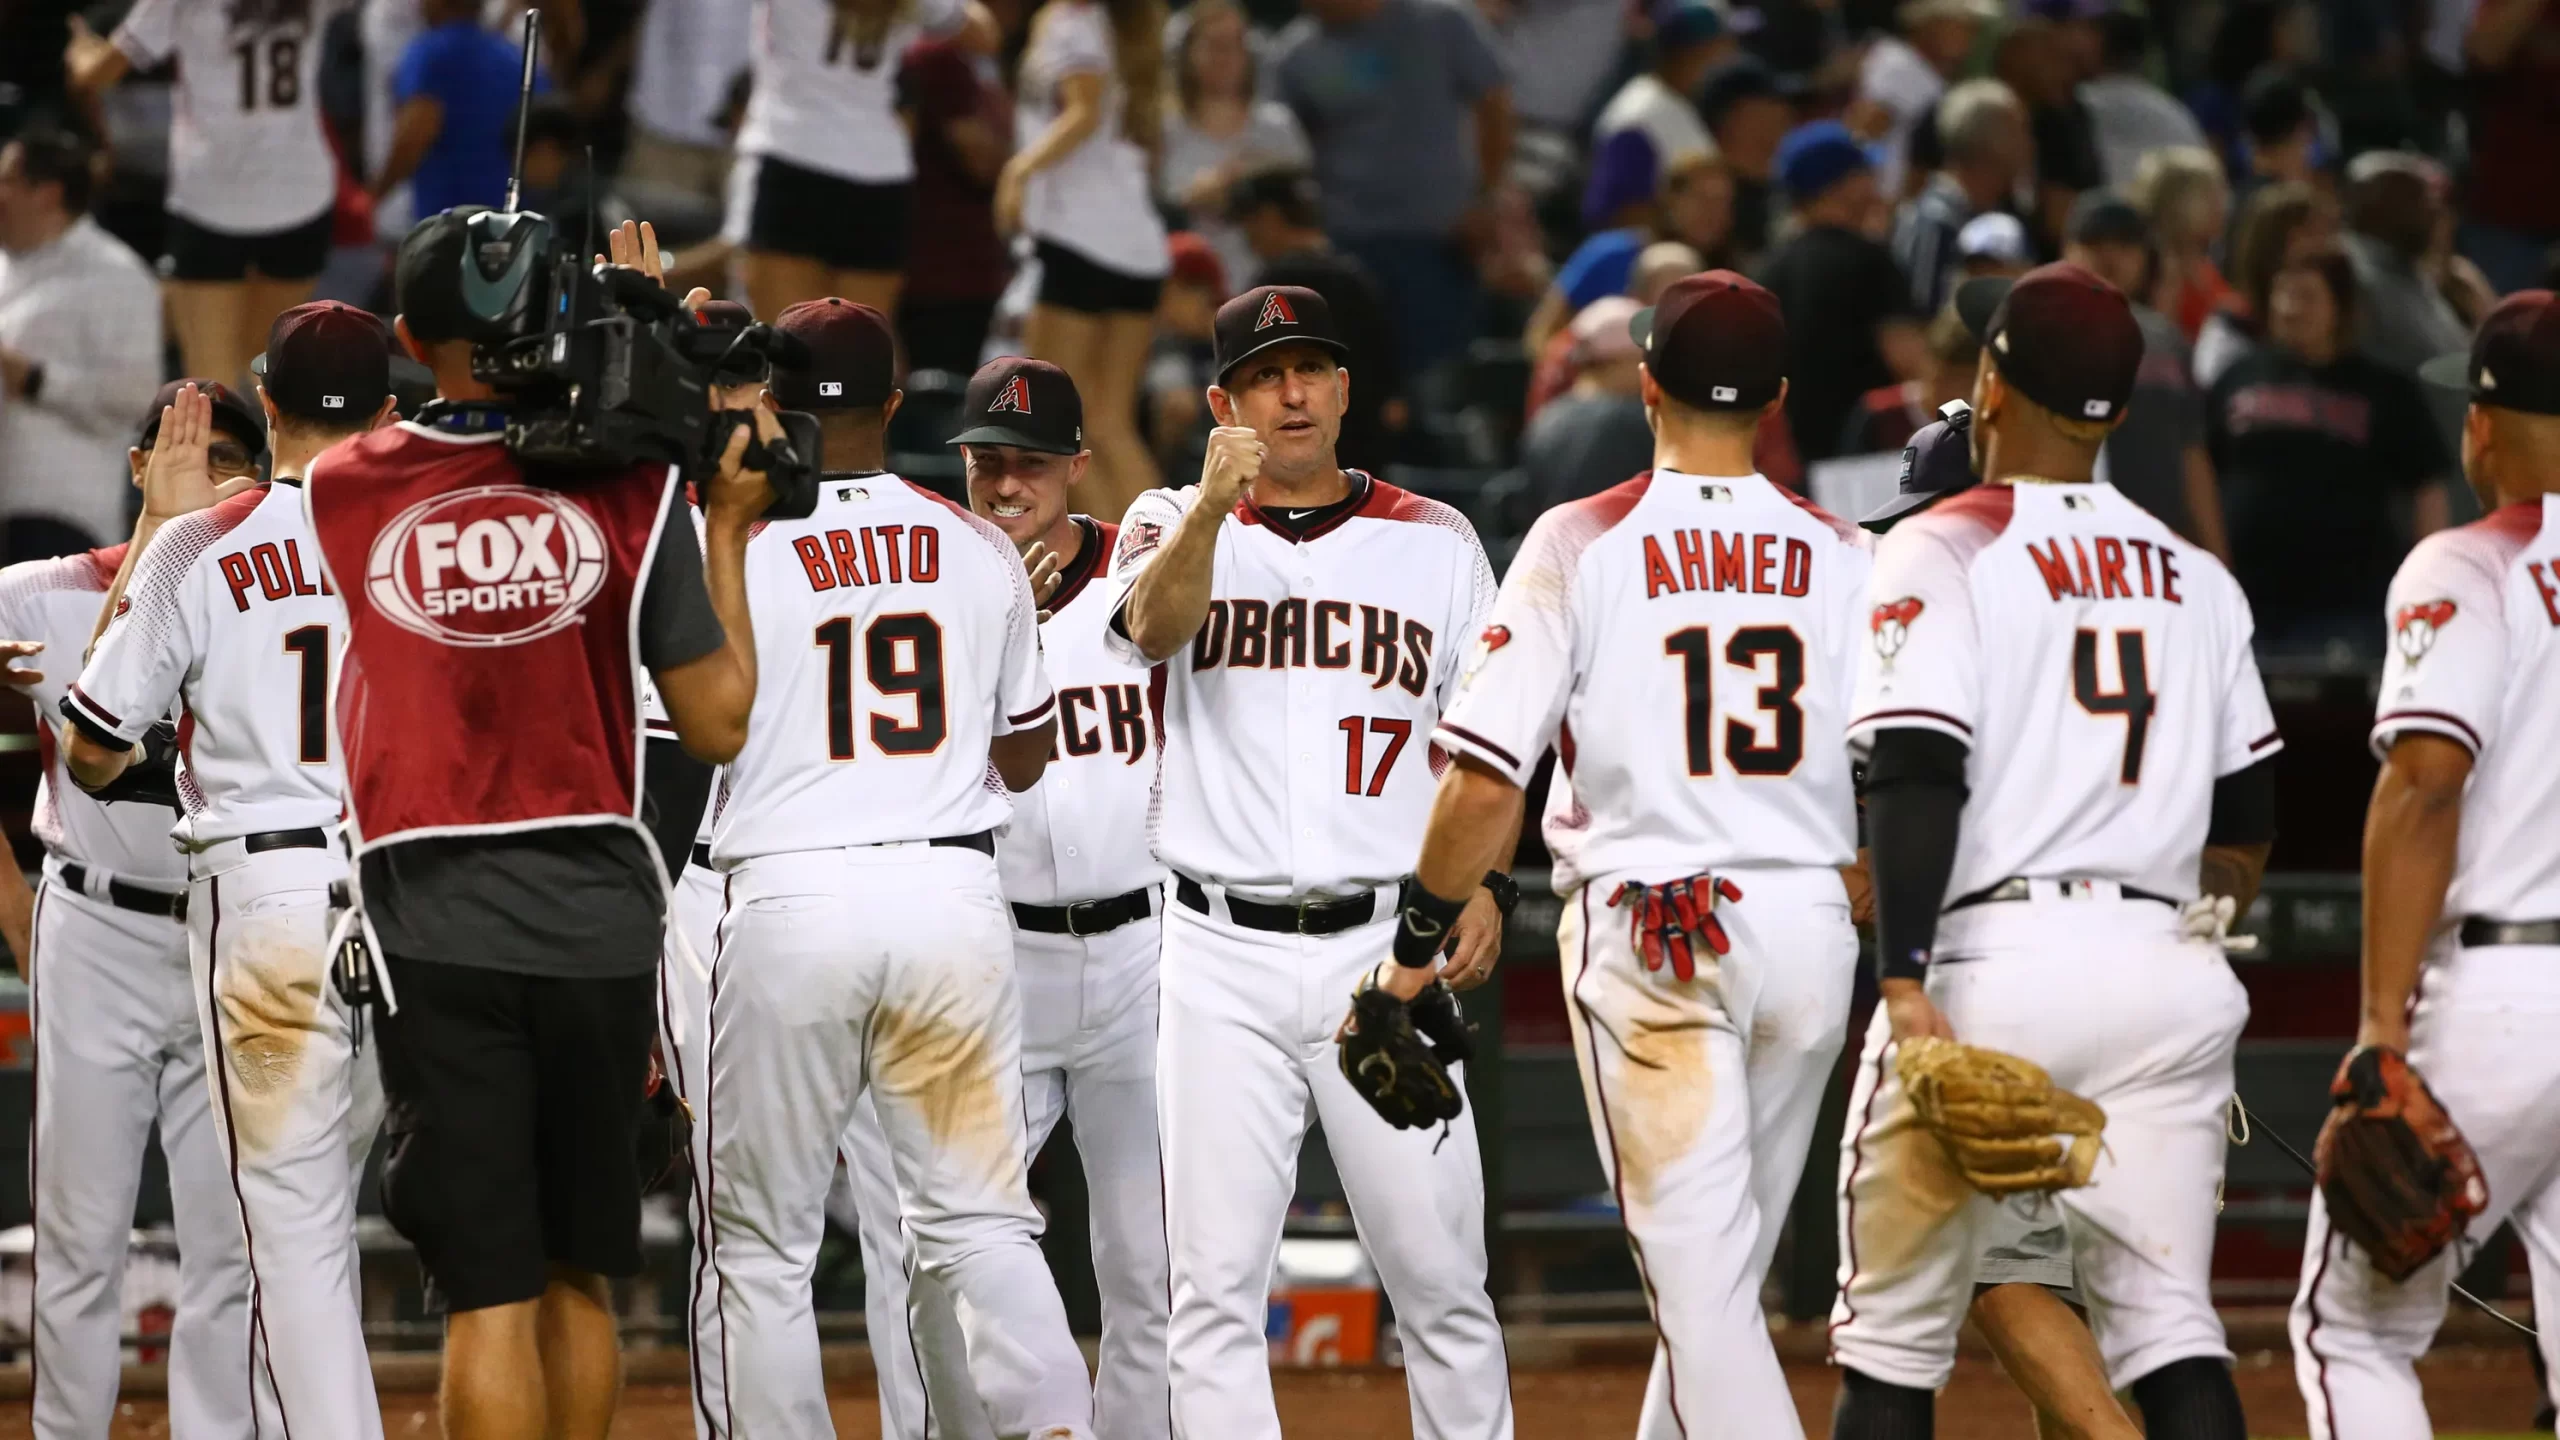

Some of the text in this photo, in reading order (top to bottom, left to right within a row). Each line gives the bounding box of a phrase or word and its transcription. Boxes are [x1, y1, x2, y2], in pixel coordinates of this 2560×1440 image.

[234, 39, 301, 112] 18
[415, 513, 562, 590] FOX
[791, 524, 940, 593] BRITO
[1642, 528, 1812, 600] AHMED
[2025, 534, 2184, 604] MARTE
[423, 580, 566, 616] SPORTS
[813, 610, 950, 763] 19
[1192, 596, 1434, 698] DBACKS
[281, 622, 346, 766] 1
[1663, 622, 1806, 780] 13
[2071, 625, 2157, 787] 4
[1338, 715, 1412, 797] 17
